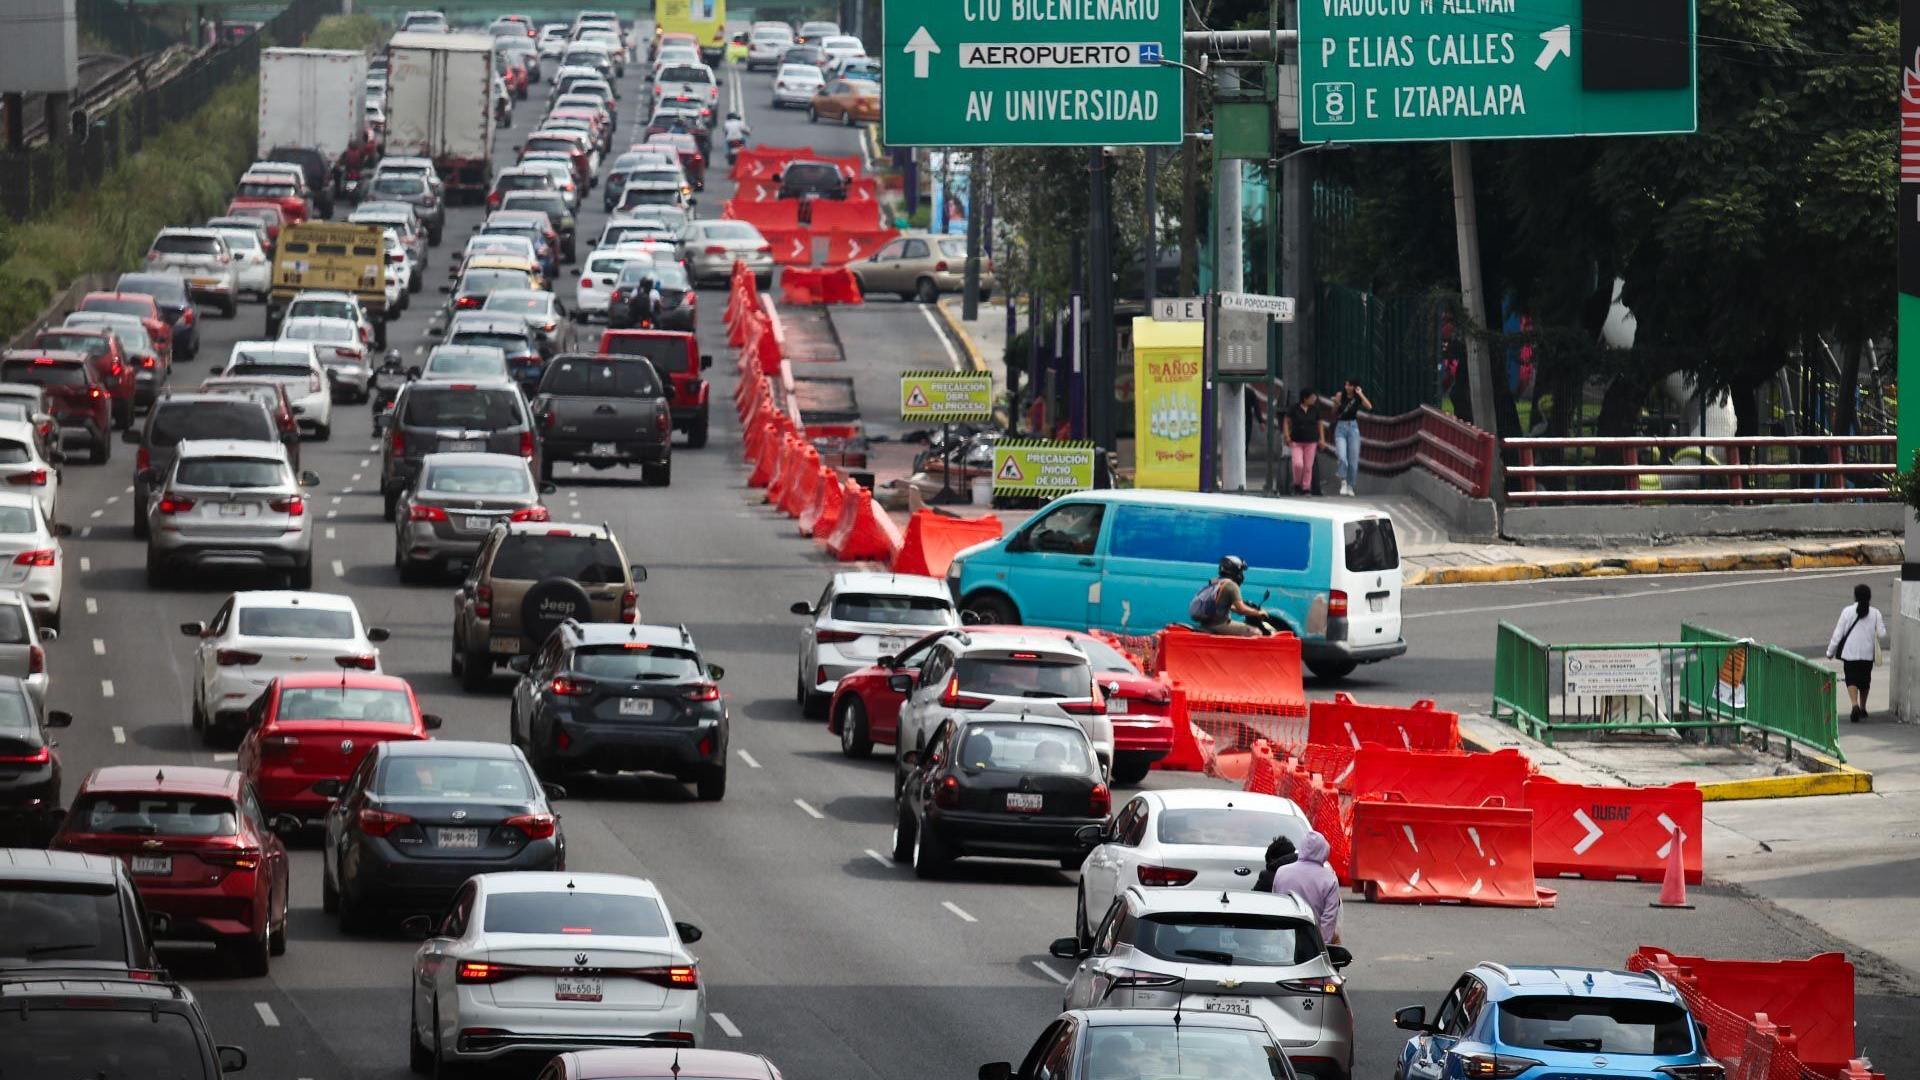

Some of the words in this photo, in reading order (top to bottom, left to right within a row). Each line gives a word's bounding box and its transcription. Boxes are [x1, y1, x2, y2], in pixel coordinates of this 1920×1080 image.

[968, 46, 1131, 64] AEROPUERTO
[1322, 37, 1336, 68] P
[1348, 35, 1415, 67] ELIAS
[1427, 32, 1515, 66] CALLES
[965, 90, 993, 122] AV
[1005, 89, 1159, 121] UNIVERSIDAD
[1325, 92, 1344, 116] 8
[1366, 88, 1379, 119] E
[1394, 84, 1527, 118] IZTAPALAPA
[1185, 302, 1194, 318] E
[540, 598, 576, 613] Jeep
